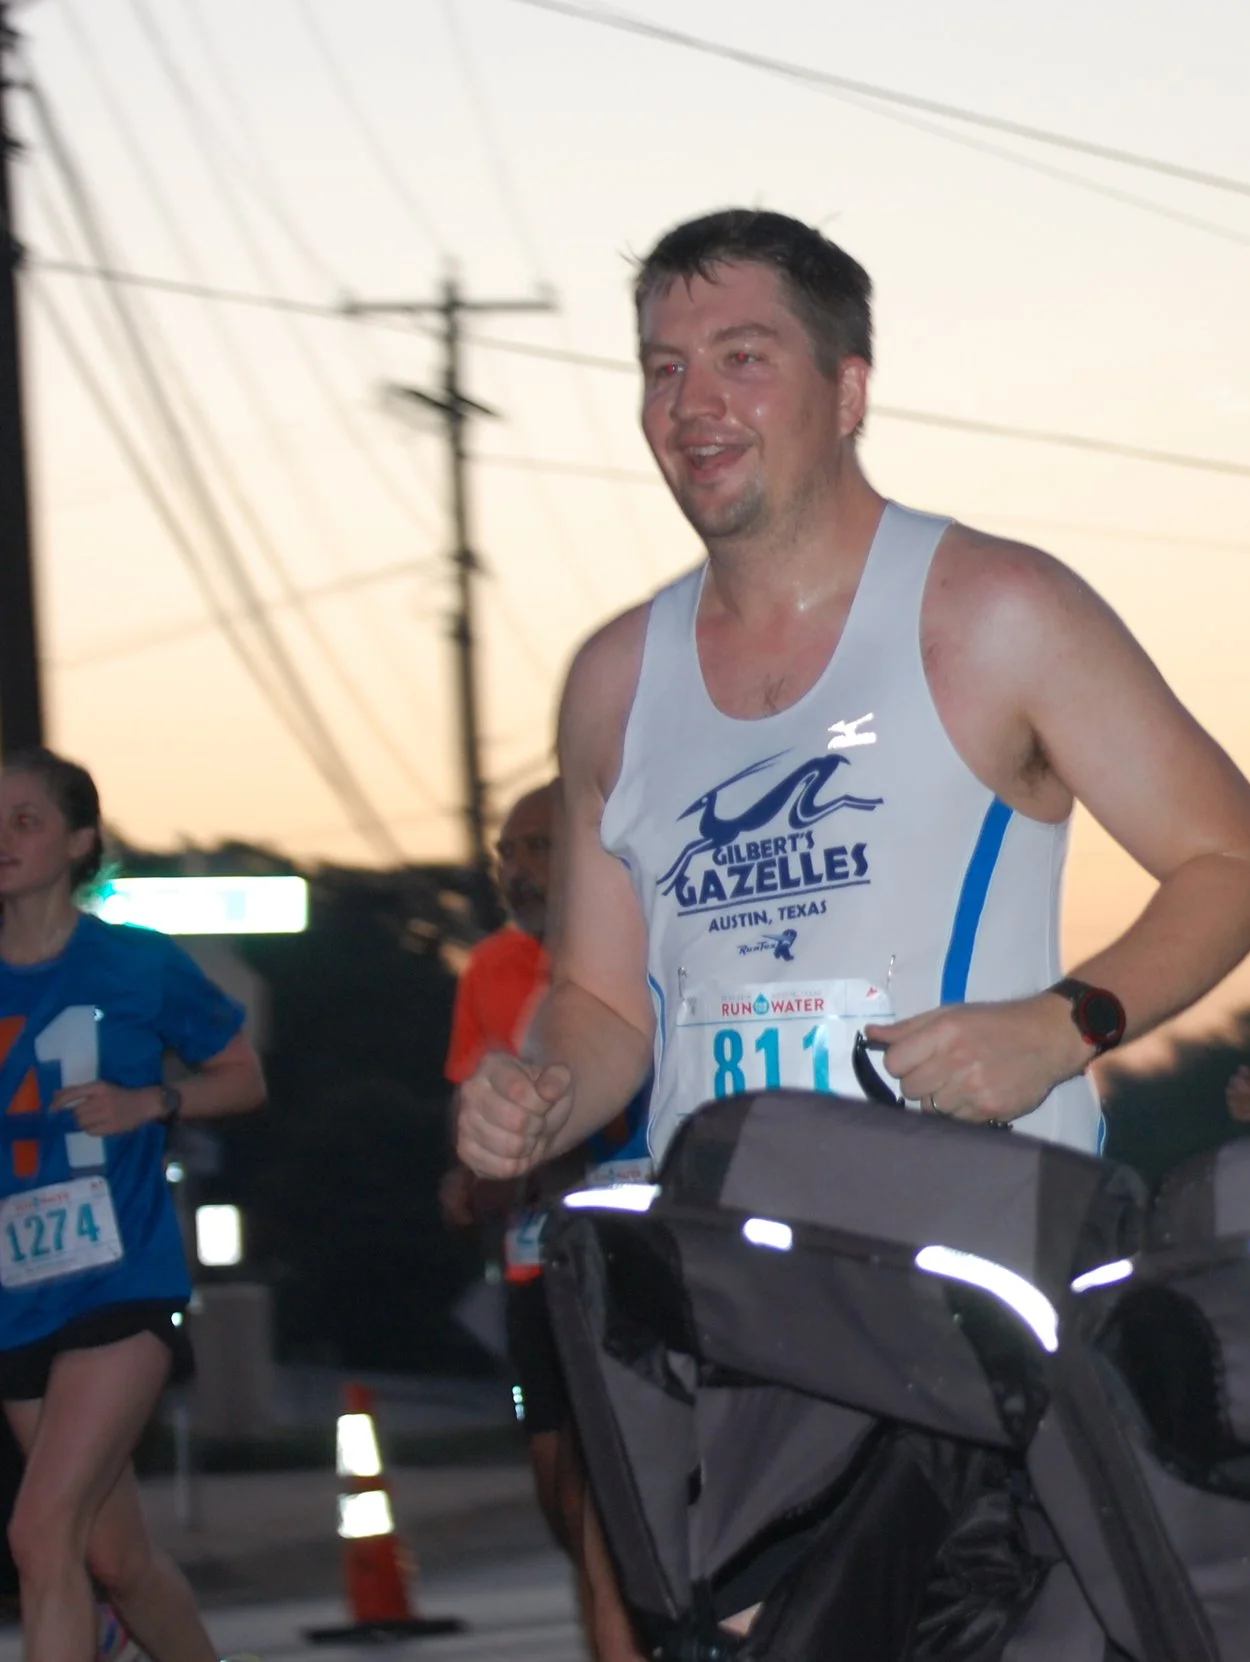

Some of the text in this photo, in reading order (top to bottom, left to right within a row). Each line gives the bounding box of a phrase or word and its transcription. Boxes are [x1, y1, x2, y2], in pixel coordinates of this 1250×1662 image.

[712, 830, 815, 866] GILBERT'S
[675, 843, 869, 907] GAZELLES
[708, 900, 827, 933] AUSTIN, TEXAS
[721, 998, 825, 1017] RUN WATER
[713, 1025, 836, 1100] 811
[6, 1203, 101, 1262] 1274
